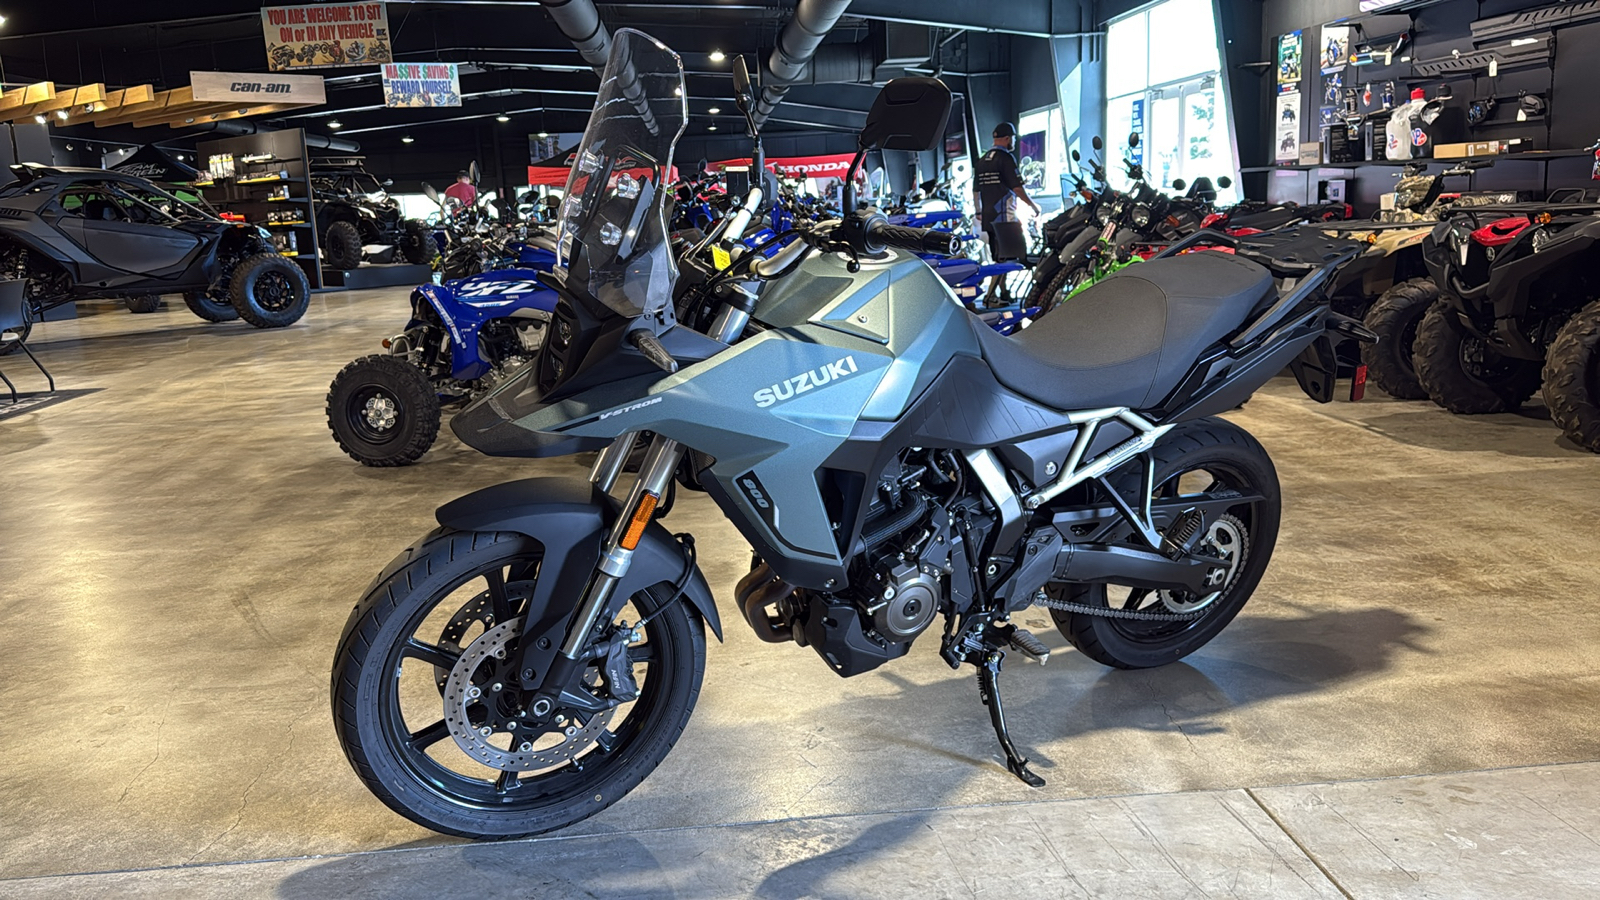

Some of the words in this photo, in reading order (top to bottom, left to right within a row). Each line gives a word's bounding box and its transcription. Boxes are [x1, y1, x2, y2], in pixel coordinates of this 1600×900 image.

[267, 9, 287, 25] YOU
[288, 8, 306, 24] ARE
[306, 6, 352, 23] WELCOME
[352, 5, 365, 21] TO
[366, 4, 381, 20] SIT
[280, 27, 293, 43] ON
[294, 29, 305, 42] or
[306, 25, 317, 41] IN
[318, 24, 336, 41] ANY
[337, 22, 374, 40] VEHICLE
[230, 82, 291, 93] can-am
[391, 80, 421, 94] REWARD
[421, 80, 453, 94] YOURSELF
[780, 161, 851, 174] HONDA
[753, 355, 858, 408] SUZUKI
[600, 396, 663, 420] V-STROM
[743, 478, 769, 508] 800
